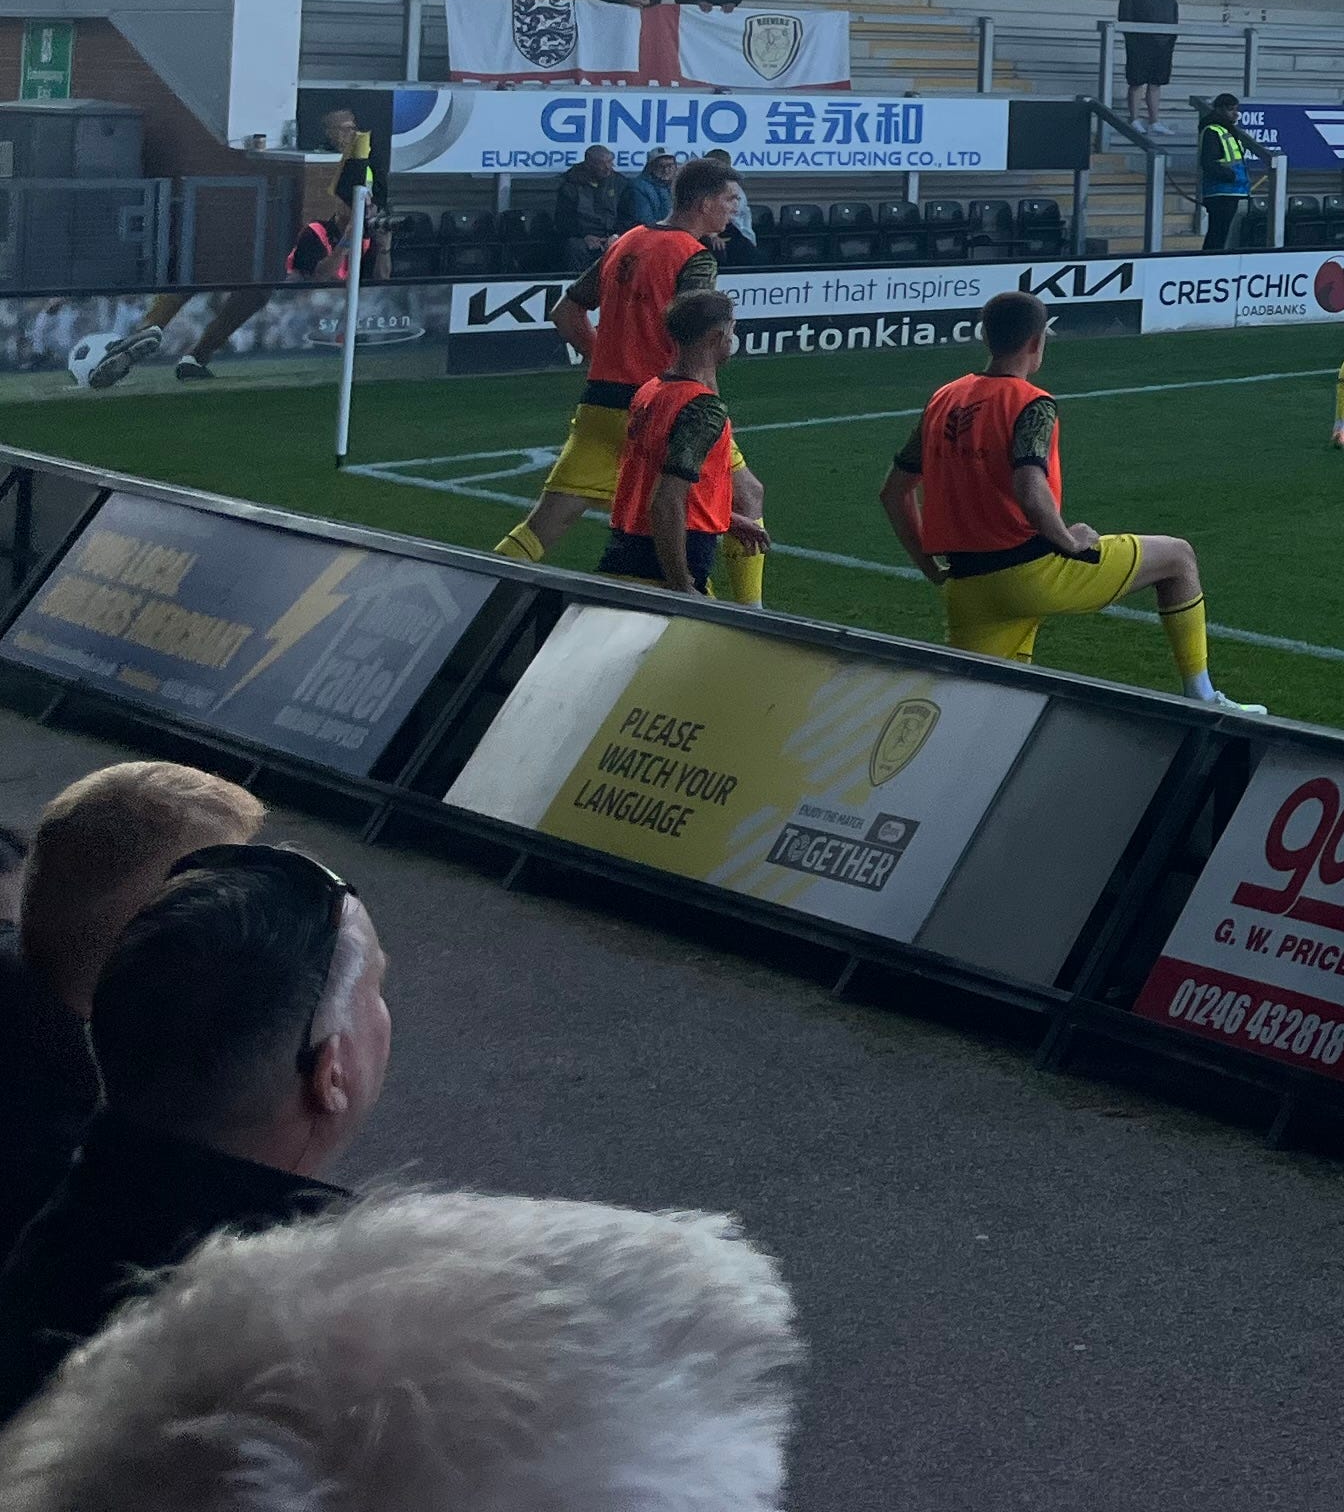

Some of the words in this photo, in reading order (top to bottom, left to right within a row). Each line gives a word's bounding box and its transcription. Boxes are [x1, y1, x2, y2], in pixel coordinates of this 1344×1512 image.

[540, 99, 747, 144] GINHO
[766, 100, 924, 145] 金永和
[1236, 111, 1265, 126] POKE
[482, 149, 577, 168] EUROPE
[732, 150, 902, 168] ANUFACTURING
[948, 150, 982, 168] LTD
[728, 281, 813, 307] ement
[822, 277, 877, 303] that
[886, 275, 981, 304] inspires
[1159, 272, 1309, 307] CRESTCHIC
[319, 315, 410, 333] sycreon
[1235, 303, 1307, 318] LOADBANKS
[619, 707, 706, 753] PLEASE
[599, 743, 676, 788] WATCH
[675, 761, 739, 807] YOUR
[574, 779, 695, 838] LANGUAGE
[799, 803, 822, 820] ENJOY
[822, 808, 840, 825] THE
[837, 813, 866, 830] MATCH
[1214, 918, 1239, 944] G.
[1244, 927, 1270, 955] W.
[1168, 979, 1246, 1035] 01246
